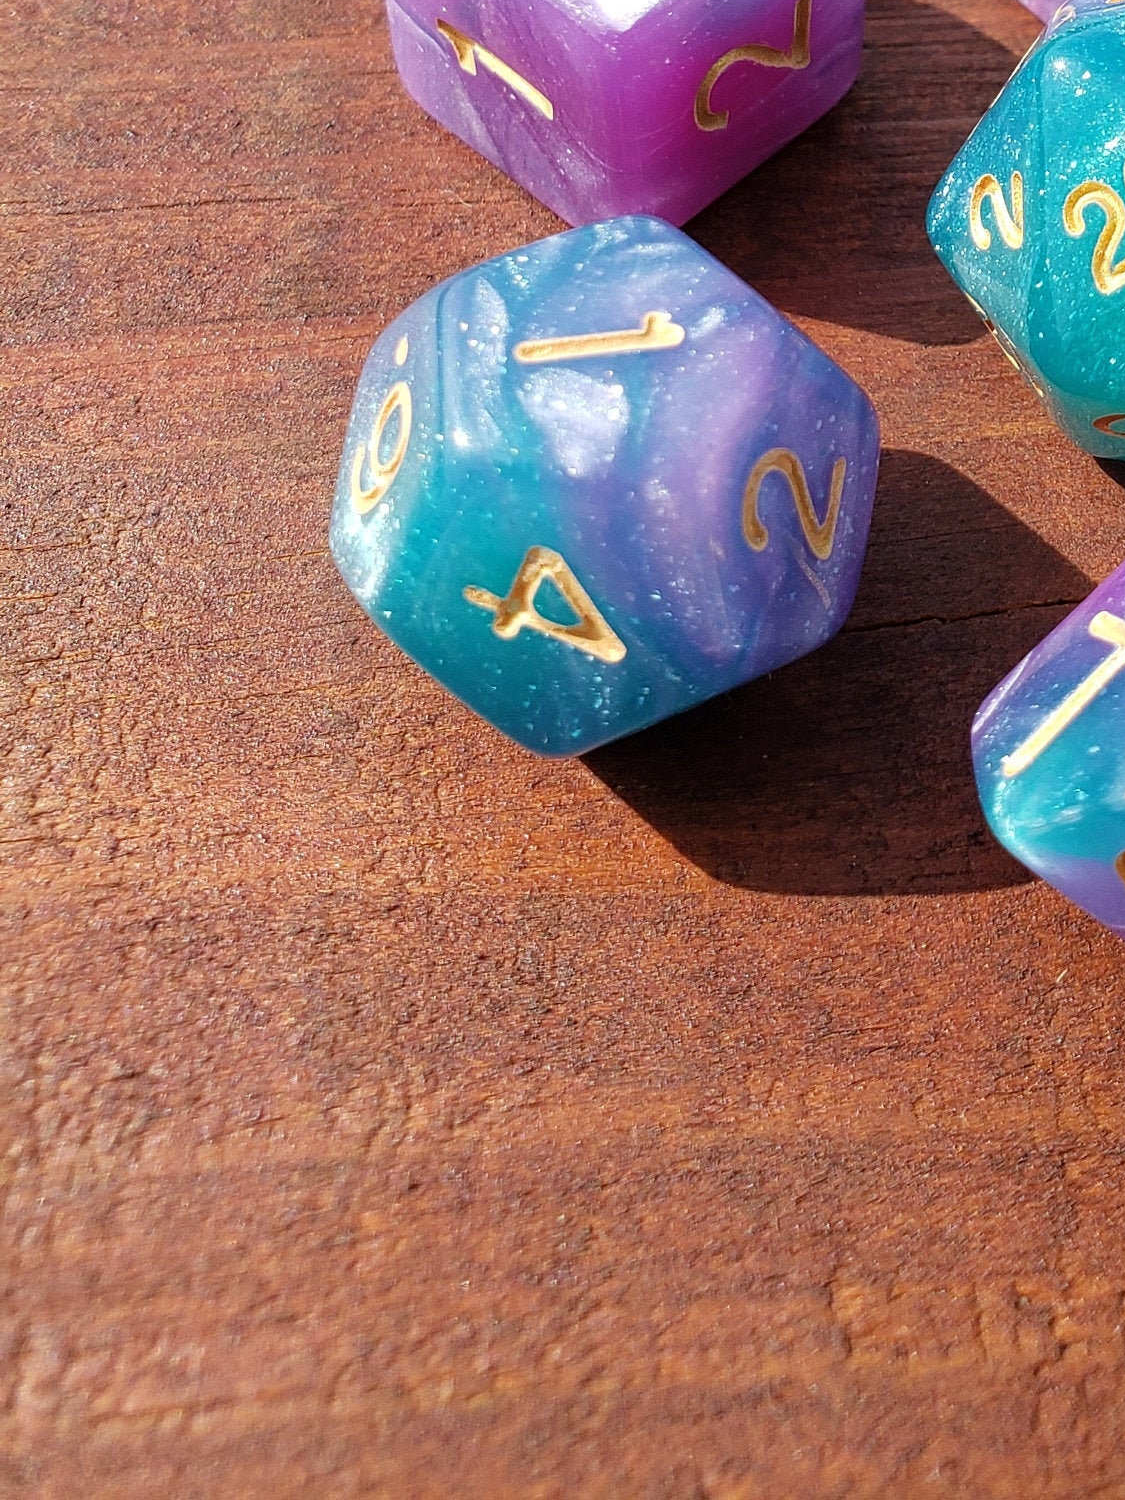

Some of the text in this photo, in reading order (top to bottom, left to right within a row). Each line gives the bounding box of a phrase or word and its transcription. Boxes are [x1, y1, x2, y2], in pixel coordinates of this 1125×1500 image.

[436, 17, 553, 120] 1
[968, 171, 1025, 251] 2
[513, 311, 685, 365] 1
[742, 447, 846, 560] 2
[462, 545, 628, 663] 4
